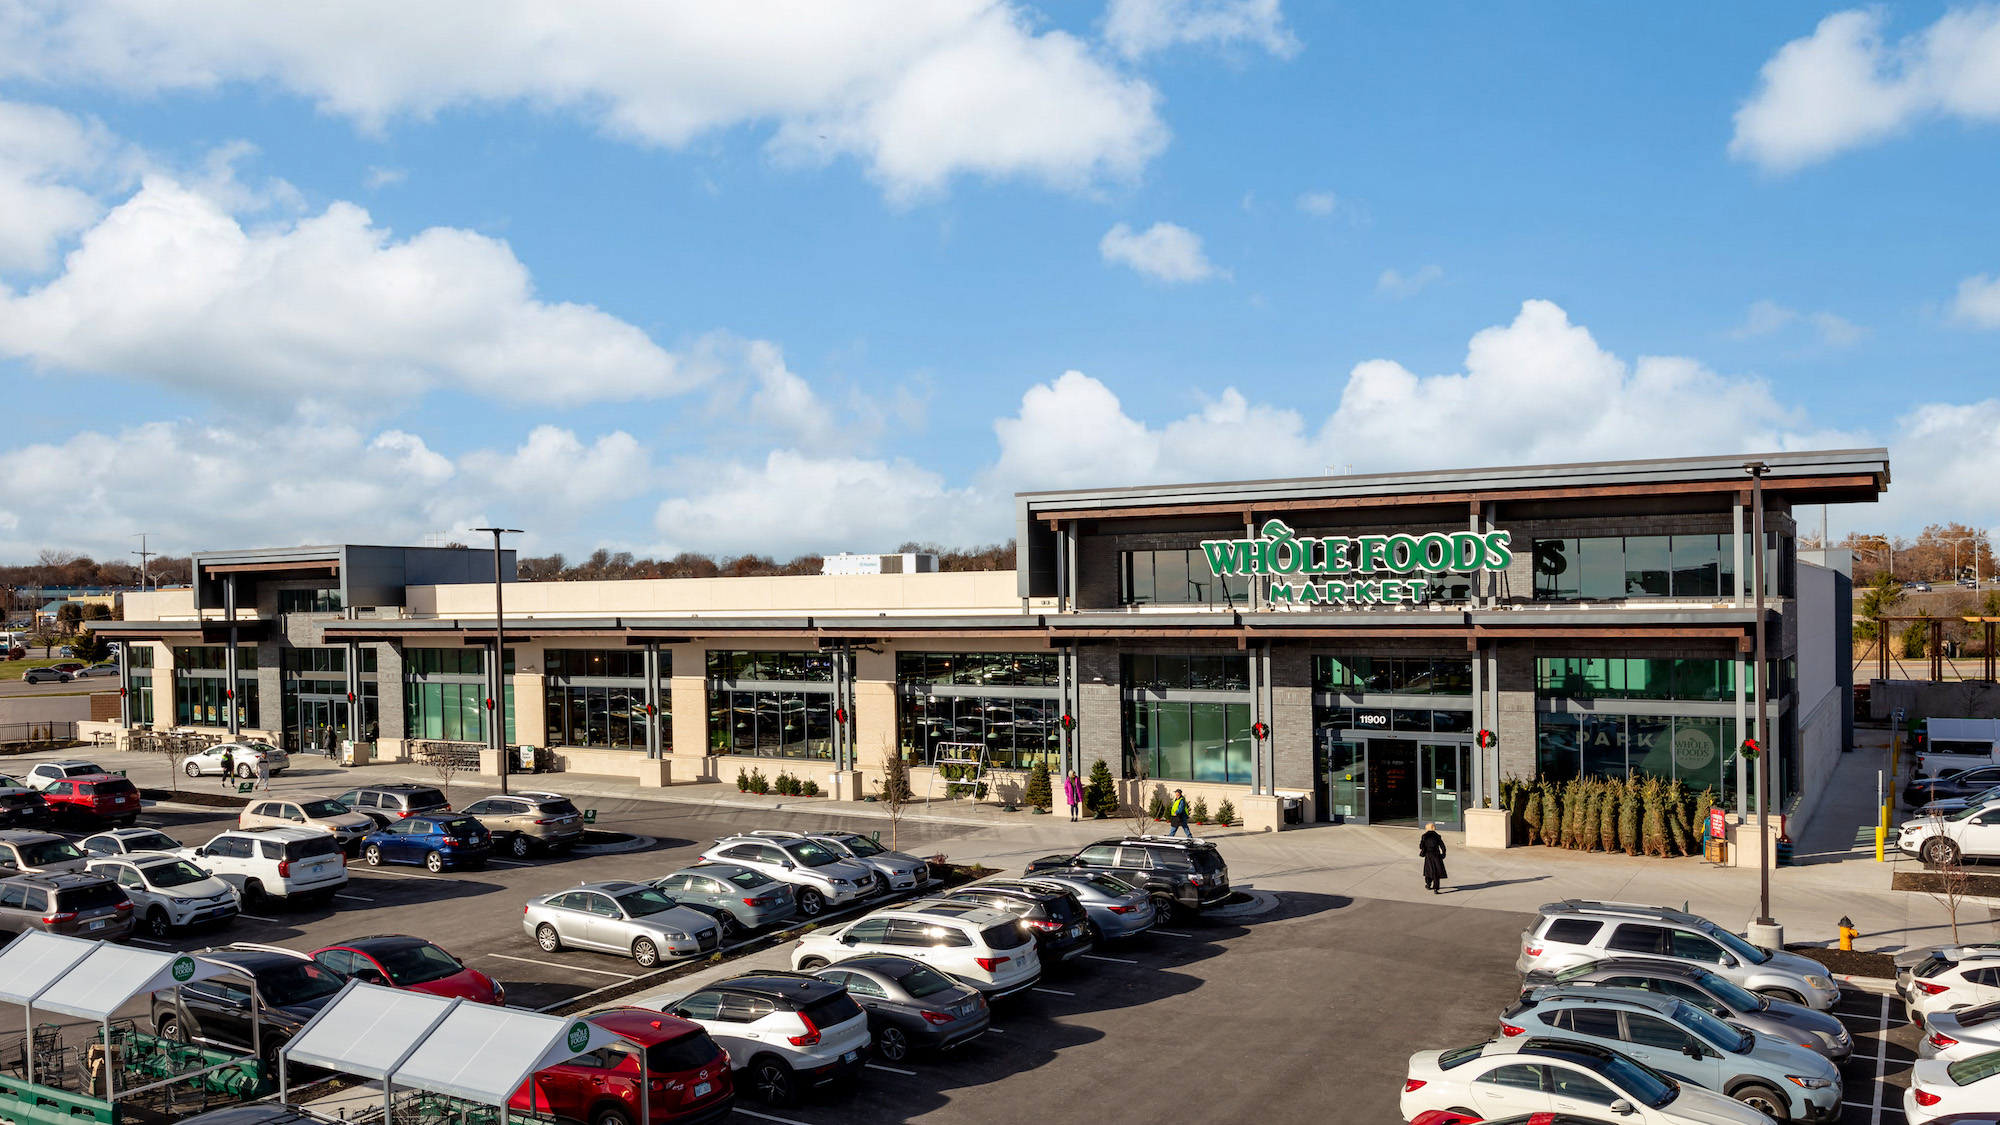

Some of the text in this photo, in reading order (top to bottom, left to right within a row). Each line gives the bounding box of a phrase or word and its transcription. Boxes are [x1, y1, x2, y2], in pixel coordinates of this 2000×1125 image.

[1200, 528, 1352, 577] WHOLE
[1357, 531, 1514, 575] FOODS
[1269, 579, 1429, 605] MARKET
[1359, 715, 1387, 725] 11900
[1575, 731, 1654, 747] PARK
[1674, 739, 1710, 750] WHOLE
[1676, 748, 1709, 758] FOODS
